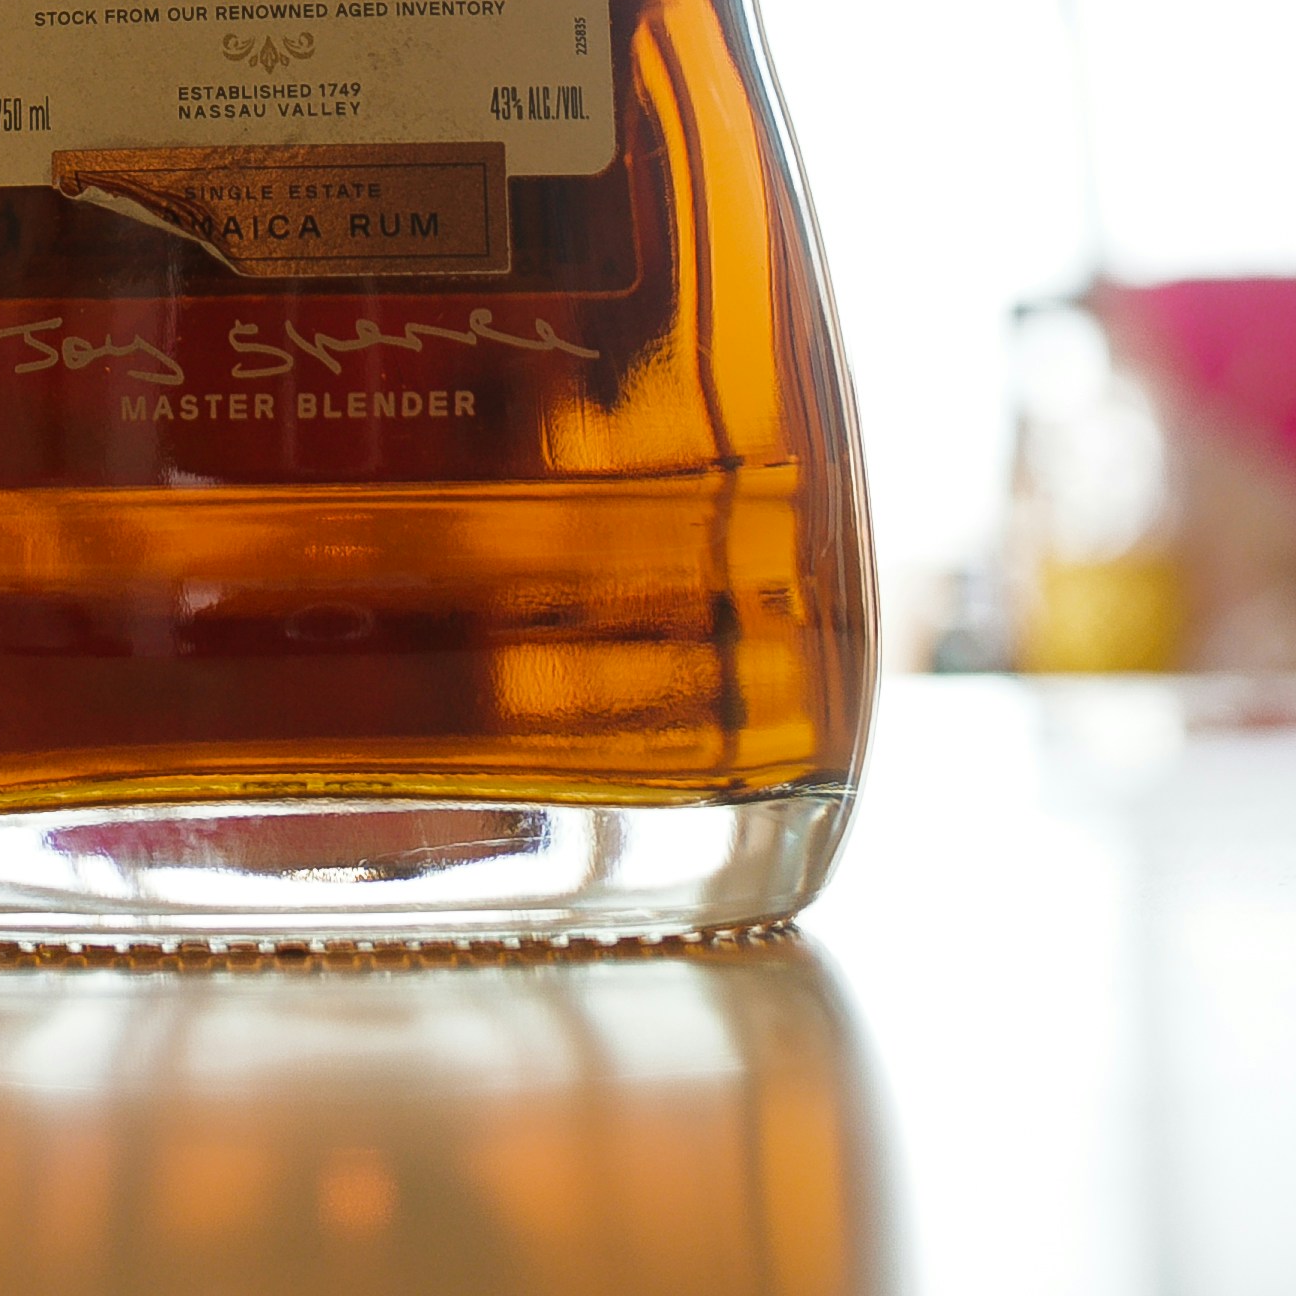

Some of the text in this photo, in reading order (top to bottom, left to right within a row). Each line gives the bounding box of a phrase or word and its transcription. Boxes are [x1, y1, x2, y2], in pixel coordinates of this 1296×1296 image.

[34, 0, 506, 27] STOCK FROM OUR RENOWNED AGED INVENTORY
[574, 16, 588, 56] 225835
[178, 82, 361, 101] ESTABLISHED 1749
[490, 85, 590, 121] 43% ALC./VOL.
[29, 95, 52, 131] ml
[178, 101, 361, 120] NASSAU VALLEY
[184, 182, 382, 201] SINGLE ESTATE
[349, 211, 440, 238] RUM
[120, 389, 477, 422] MASTER BLENDER
